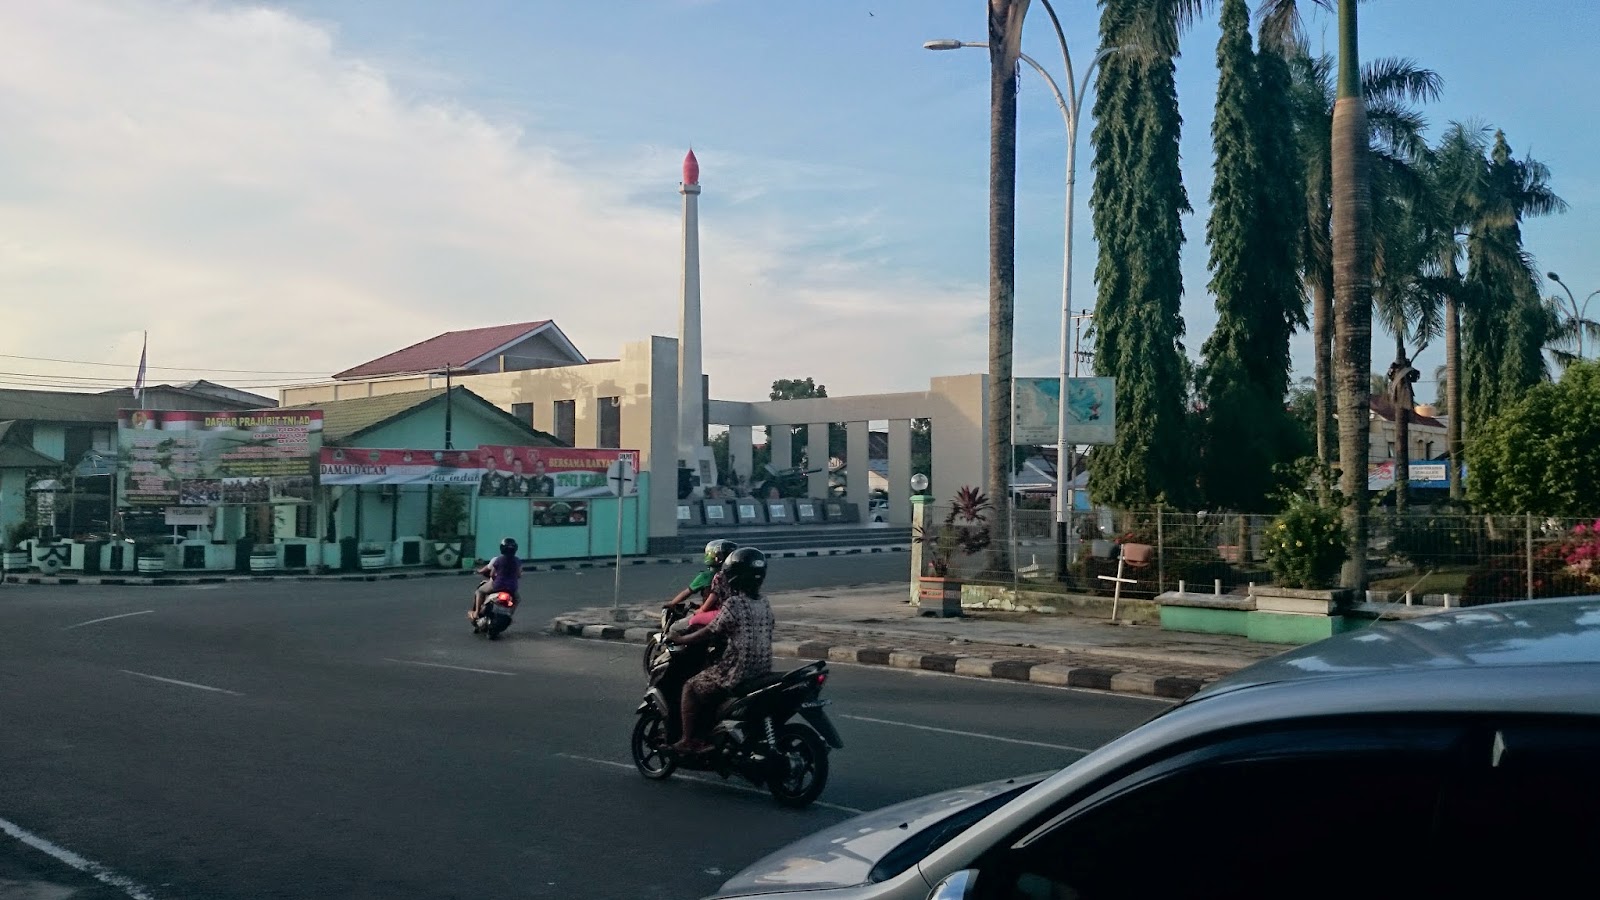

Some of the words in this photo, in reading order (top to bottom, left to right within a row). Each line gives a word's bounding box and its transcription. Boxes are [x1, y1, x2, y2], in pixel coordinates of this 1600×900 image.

[205, 417, 238, 427] DAFTAR
[239, 416, 280, 427] PRAJURIT
[282, 416, 297, 426] TNI
[300, 415, 310, 425] AD
[548, 458, 585, 468] BERSAMA
[320, 464, 352, 475] DAMAI
[354, 464, 387, 476] DALAM
[430, 473, 445, 482] itu
[450, 472, 479, 482] indah
[556, 473, 578, 487] TNI
